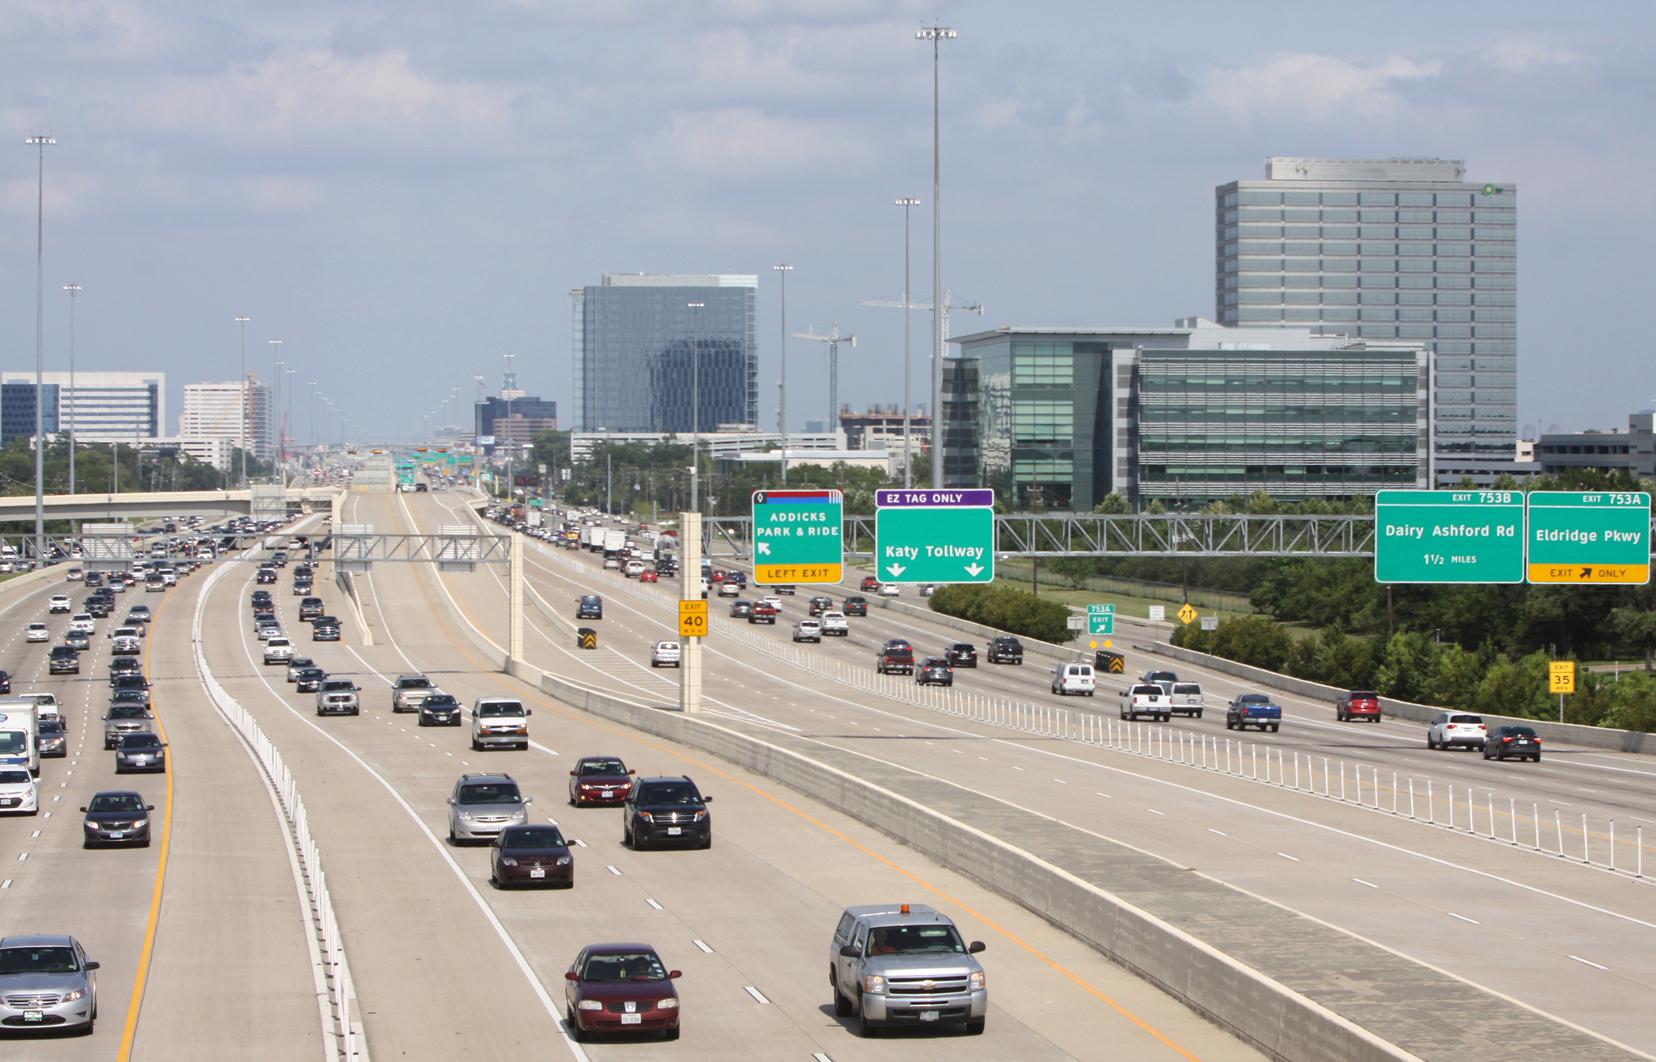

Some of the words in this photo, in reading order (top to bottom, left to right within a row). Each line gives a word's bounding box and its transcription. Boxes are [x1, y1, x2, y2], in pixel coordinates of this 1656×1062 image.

[886, 493, 900, 504] EZ
[905, 493, 927, 504] TAG
[932, 493, 963, 503] ONLY
[1452, 493, 1472, 502] EXIT
[1478, 492, 1511, 504] 753B
[1582, 494, 1602, 503] EXIT
[1608, 493, 1641, 505] 753A
[769, 512, 827, 522] ADDICKS
[757, 527, 790, 537] PARK
[796, 527, 804, 536] &
[808, 527, 839, 536] RIDE
[1385, 524, 1424, 540] Dairy
[1432, 524, 1490, 537] Ashford
[1496, 525, 1515, 537] Rd
[1536, 529, 1597, 544] Eldridge
[1604, 530, 1641, 545] Pkwy
[886, 546, 919, 560] Katy
[925, 545, 984, 560] Tollway
[1451, 555, 1477, 564] MILES
[767, 569, 796, 578] LEFT
[802, 568, 829, 577] EXIT
[1550, 569, 1572, 578] EXIT
[1598, 568, 1626, 578] ONLY
[684, 616, 703, 626] 40
[1554, 675, 1570, 685] 35
